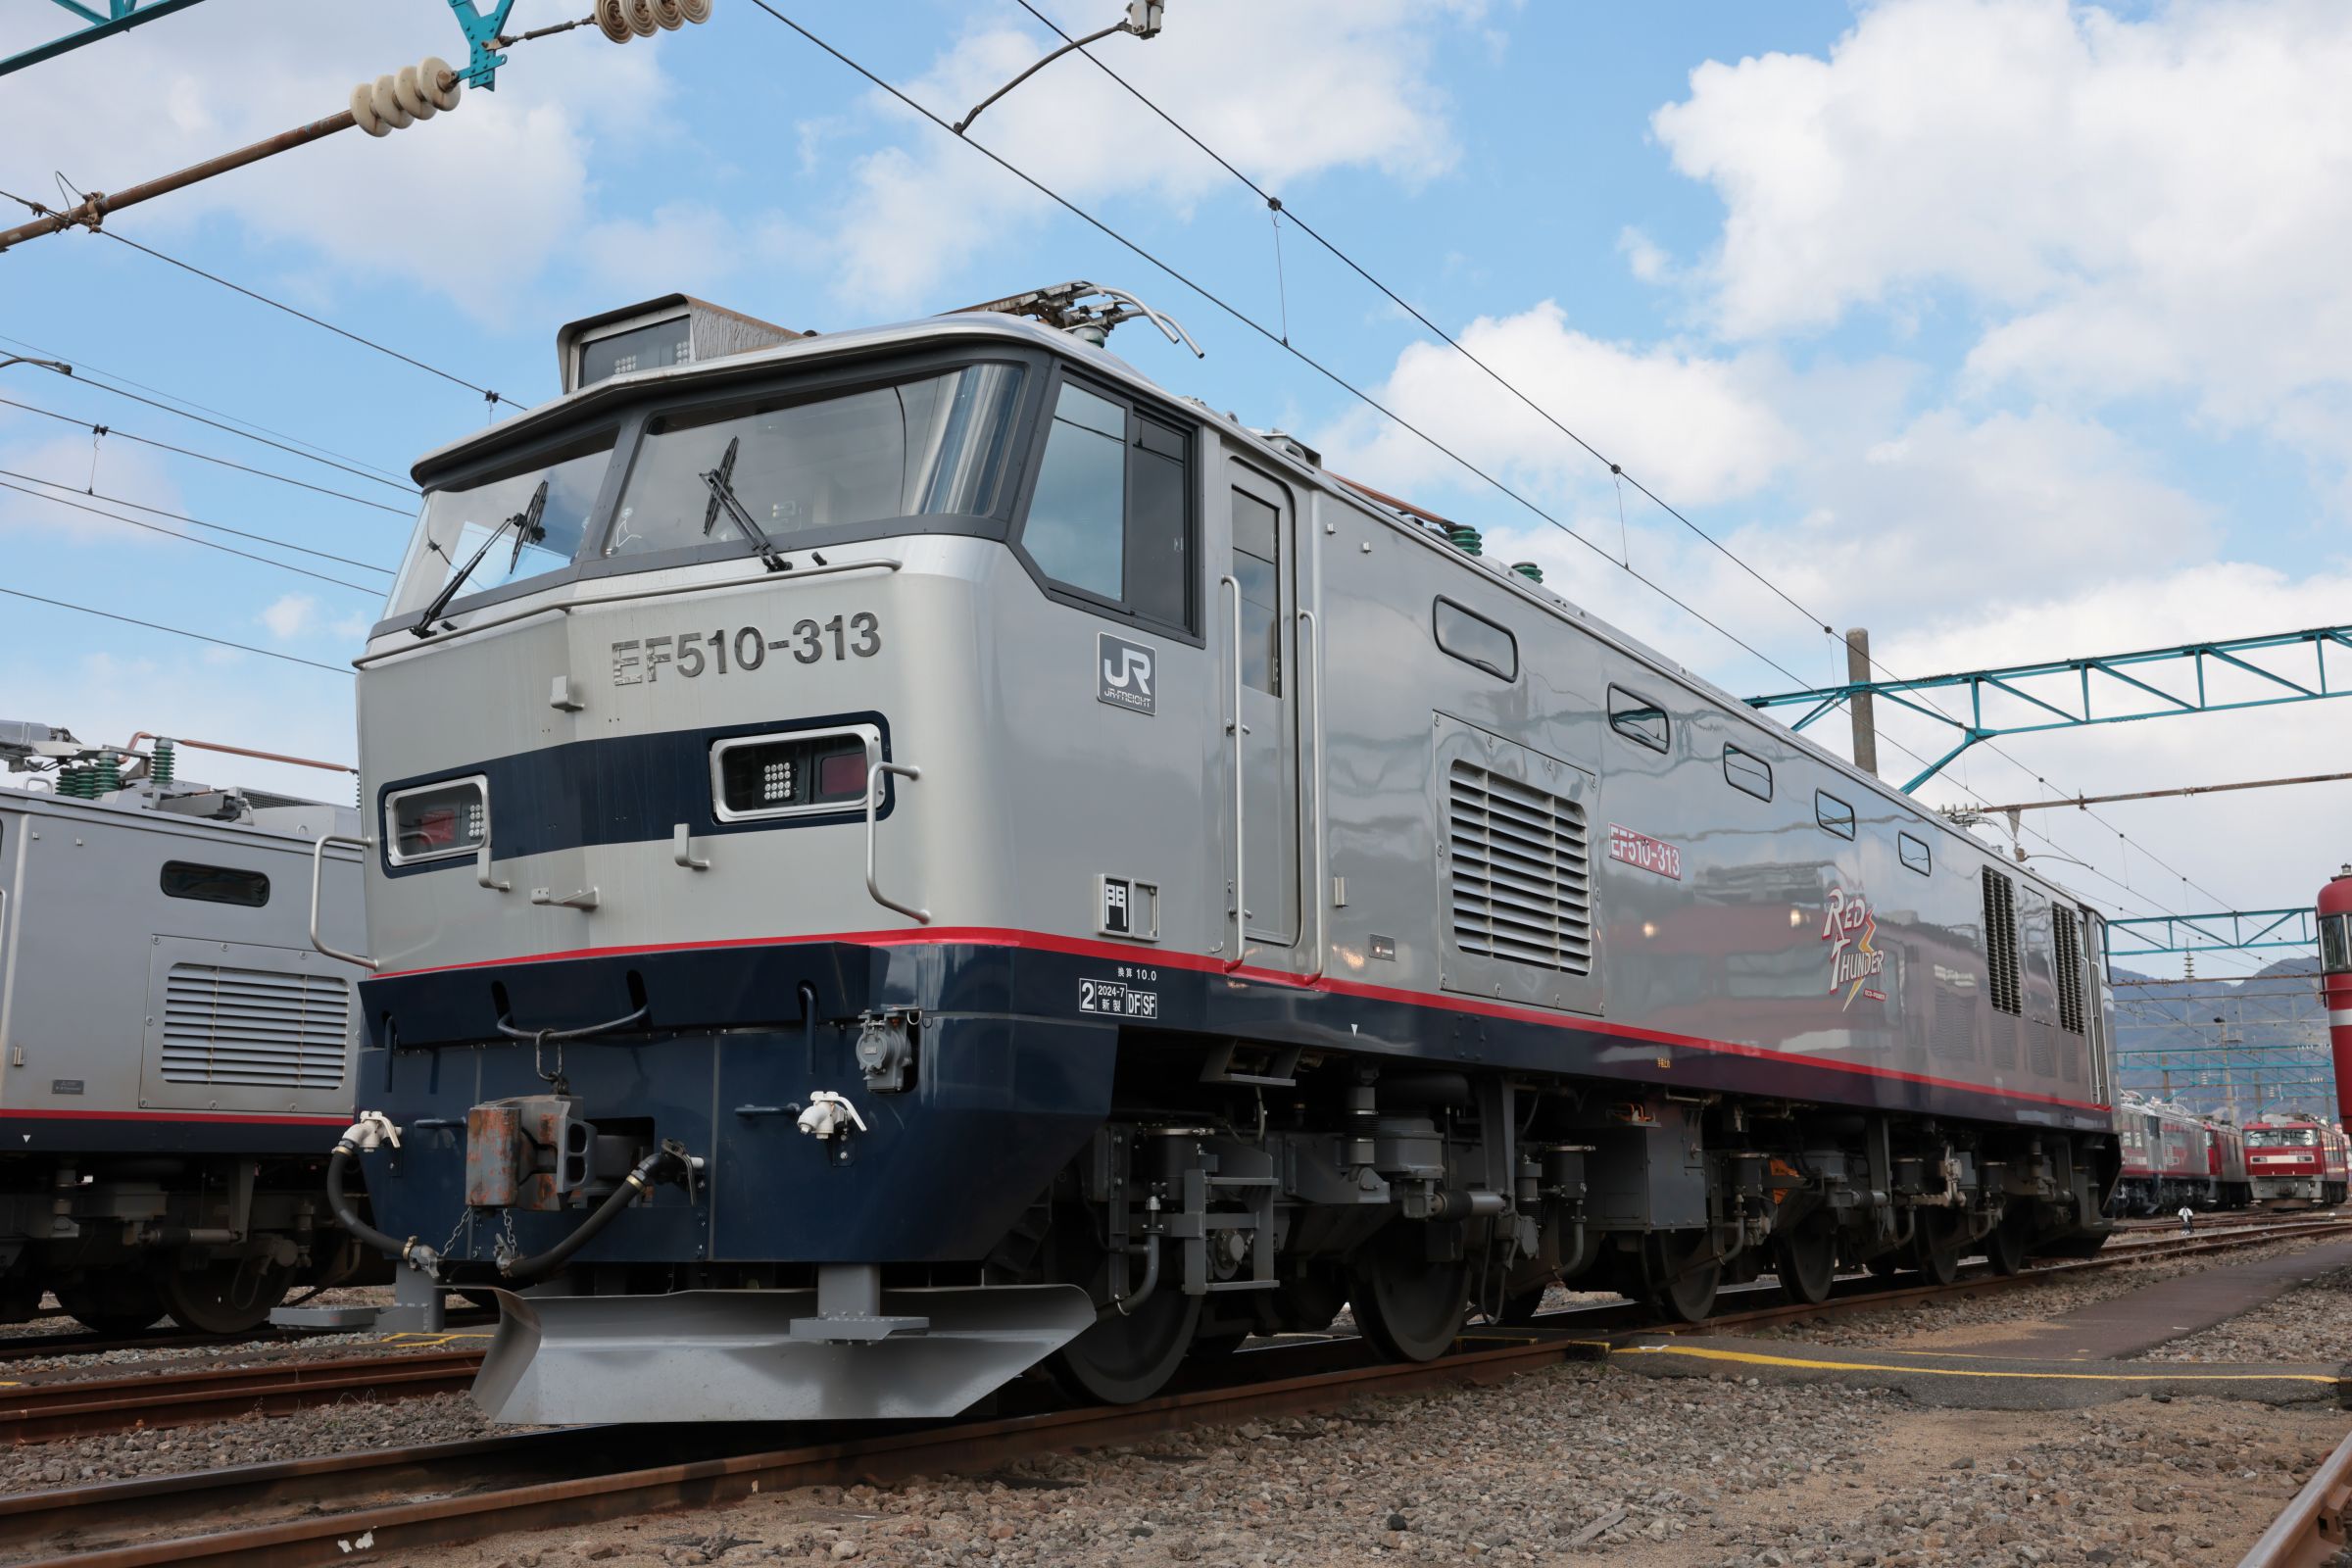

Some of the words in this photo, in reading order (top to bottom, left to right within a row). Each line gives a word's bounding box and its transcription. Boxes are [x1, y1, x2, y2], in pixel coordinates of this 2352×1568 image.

[612, 612, 881, 687] EF510-313
[1103, 647, 1152, 696] JR
[1610, 826, 1681, 876] EF510-313
[1822, 888, 1866, 941] RED
[1136, 968, 1157, 981] 10.0
[1830, 934, 1885, 994] THUNDER
[1081, 982, 1095, 1010] 2
[1098, 985, 1125, 998] 2024-7
[1102, 999, 1122, 1012] 新製
[1128, 994, 1141, 1013] DF
[1143, 996, 1155, 1016] SF
